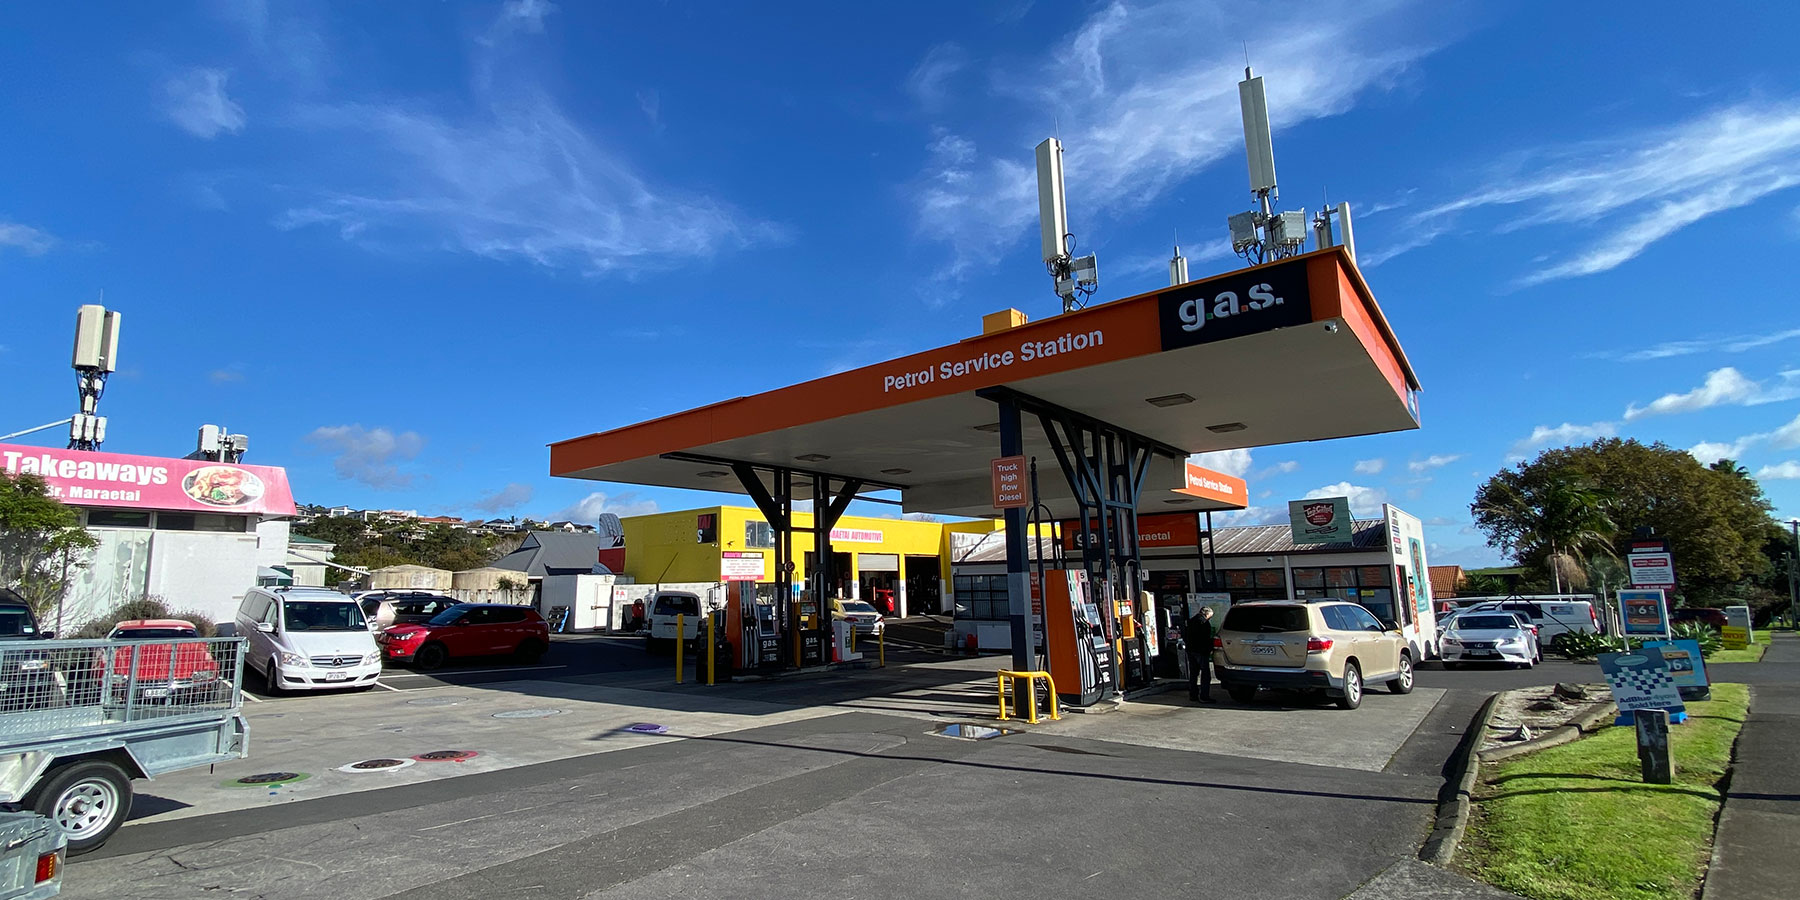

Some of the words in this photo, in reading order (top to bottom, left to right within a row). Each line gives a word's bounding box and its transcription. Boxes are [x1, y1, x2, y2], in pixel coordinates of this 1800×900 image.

[884, 365, 934, 393] Petrol
[939, 352, 1014, 380] Service
[1020, 329, 1103, 362] Station
[3, 451, 168, 485] Takeaways
[997, 463, 1018, 472] Truck
[1000, 473, 1017, 482] high
[1189, 473, 1203, 487] Petrol
[1203, 477, 1218, 491] Service
[1218, 481, 1233, 494] Station
[69, 486, 141, 501] Maraetai
[999, 493, 1022, 501] Diesel
[851, 531, 882, 541] AUTOMOTIVE
[1619, 695, 1651, 703] AdBlue
